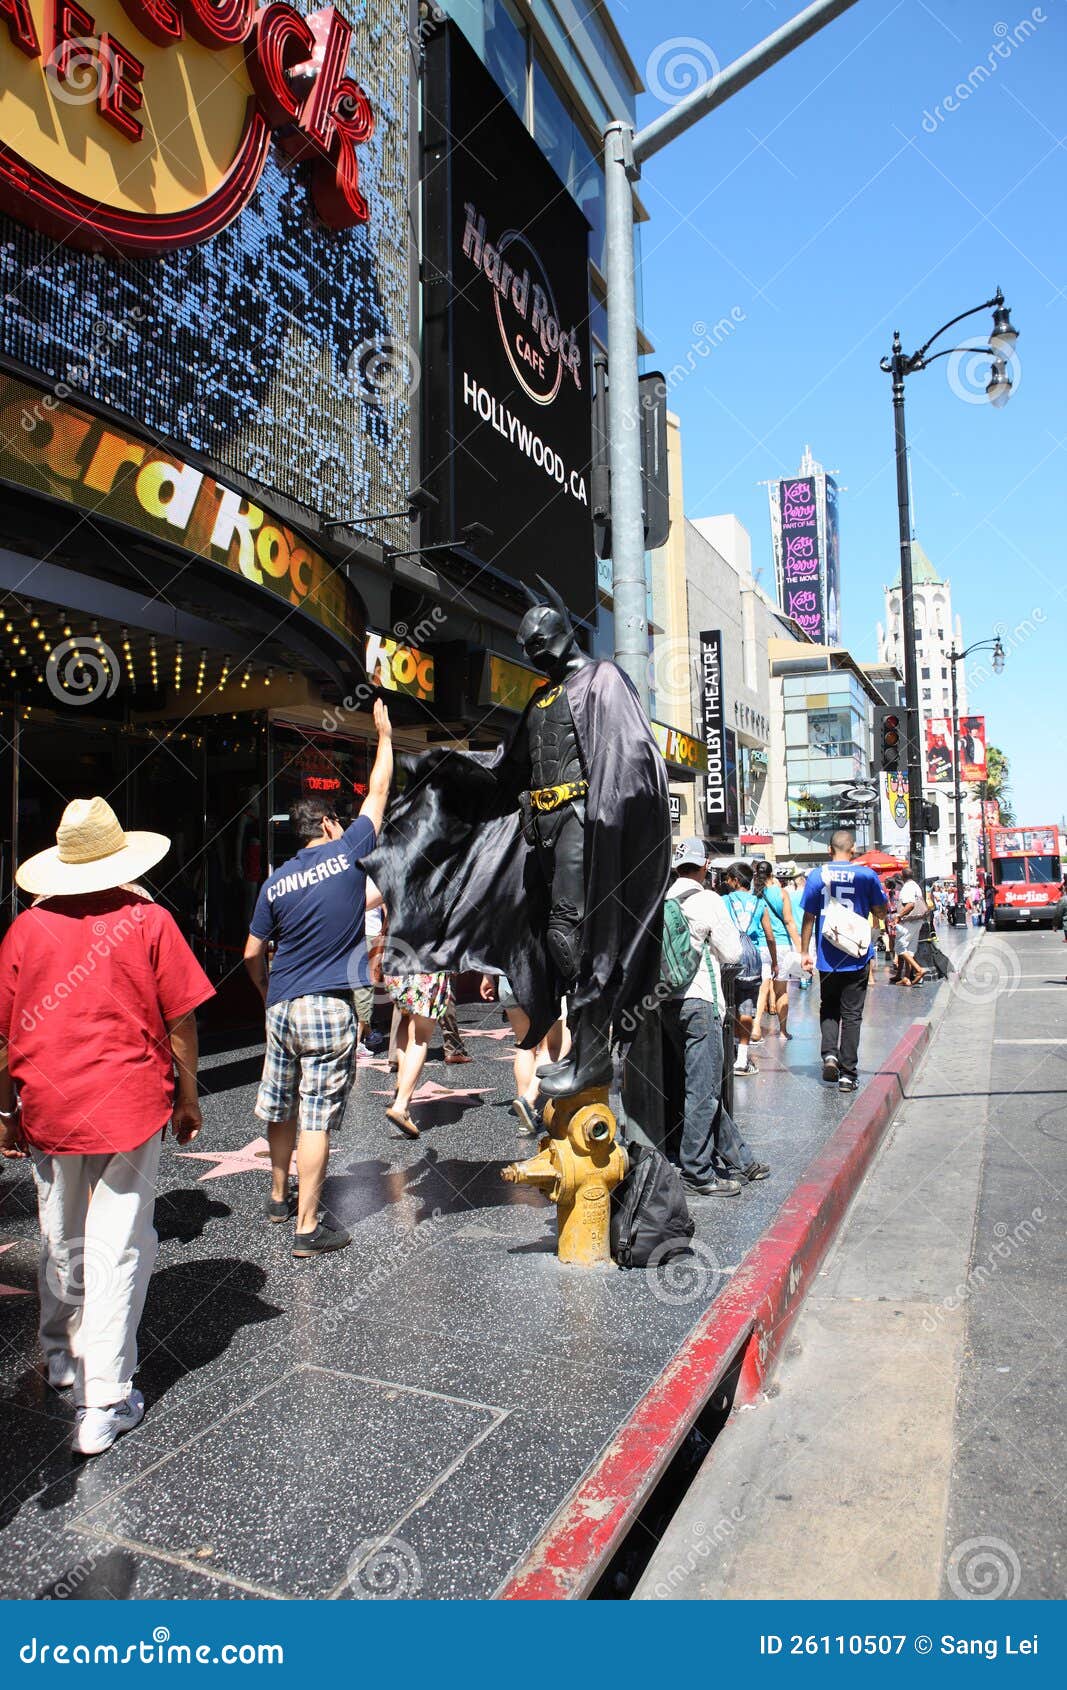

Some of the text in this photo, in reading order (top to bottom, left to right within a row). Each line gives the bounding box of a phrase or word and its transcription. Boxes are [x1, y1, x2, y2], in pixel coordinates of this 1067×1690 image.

[462, 201, 582, 390] Hard Rock
[515, 334, 546, 380] CAFE
[463, 372, 588, 506] HOLLYWOOD, CA
[783, 483, 811, 504] Katy
[783, 503, 815, 523] Perry
[211, 482, 314, 597] Roc
[786, 536, 813, 557] Katy
[786, 557, 818, 577] Perry
[789, 591, 816, 612] Katy
[366, 631, 434, 692] Roc
[703, 641, 722, 785] DOLBY THEATRE
[267, 854, 350, 903] CONVERGE
[1005, 891, 1049, 903] Starline
[821, 885, 856, 916] 15
